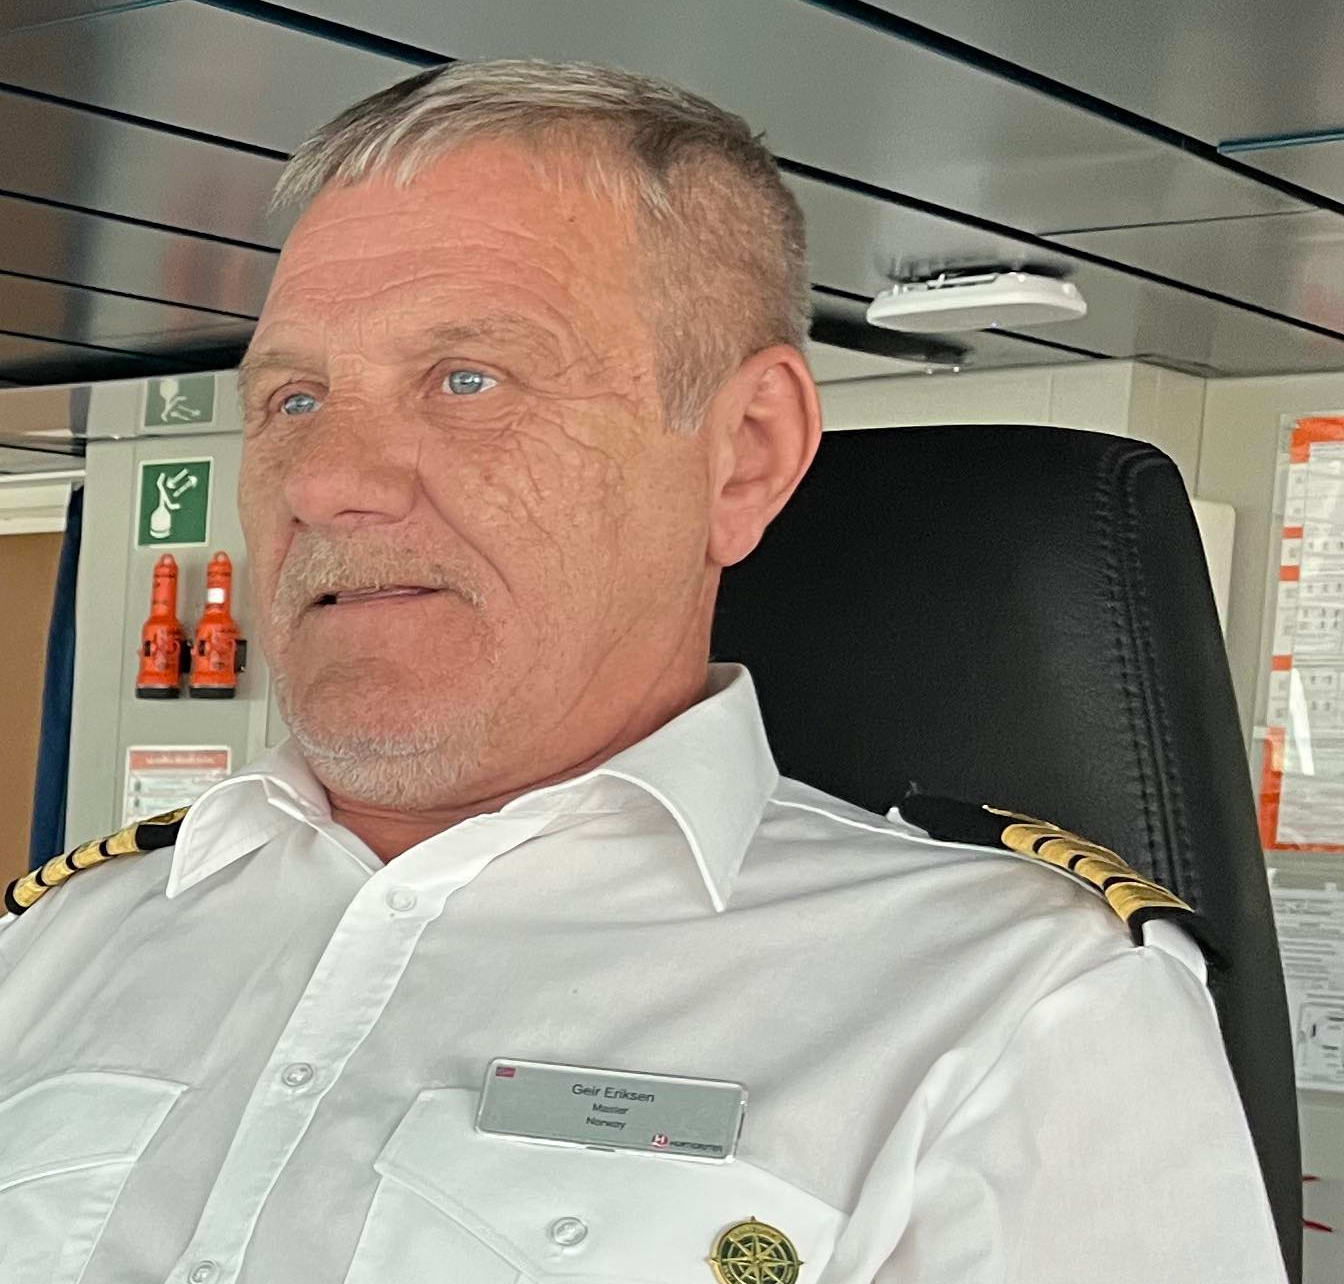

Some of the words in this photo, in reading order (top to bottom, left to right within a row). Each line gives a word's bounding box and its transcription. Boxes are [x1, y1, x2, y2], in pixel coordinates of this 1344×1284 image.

[571, 1083, 602, 1097] Geir
[603, 1086, 656, 1103] Eriksen
[585, 1115, 627, 1131] Norway
